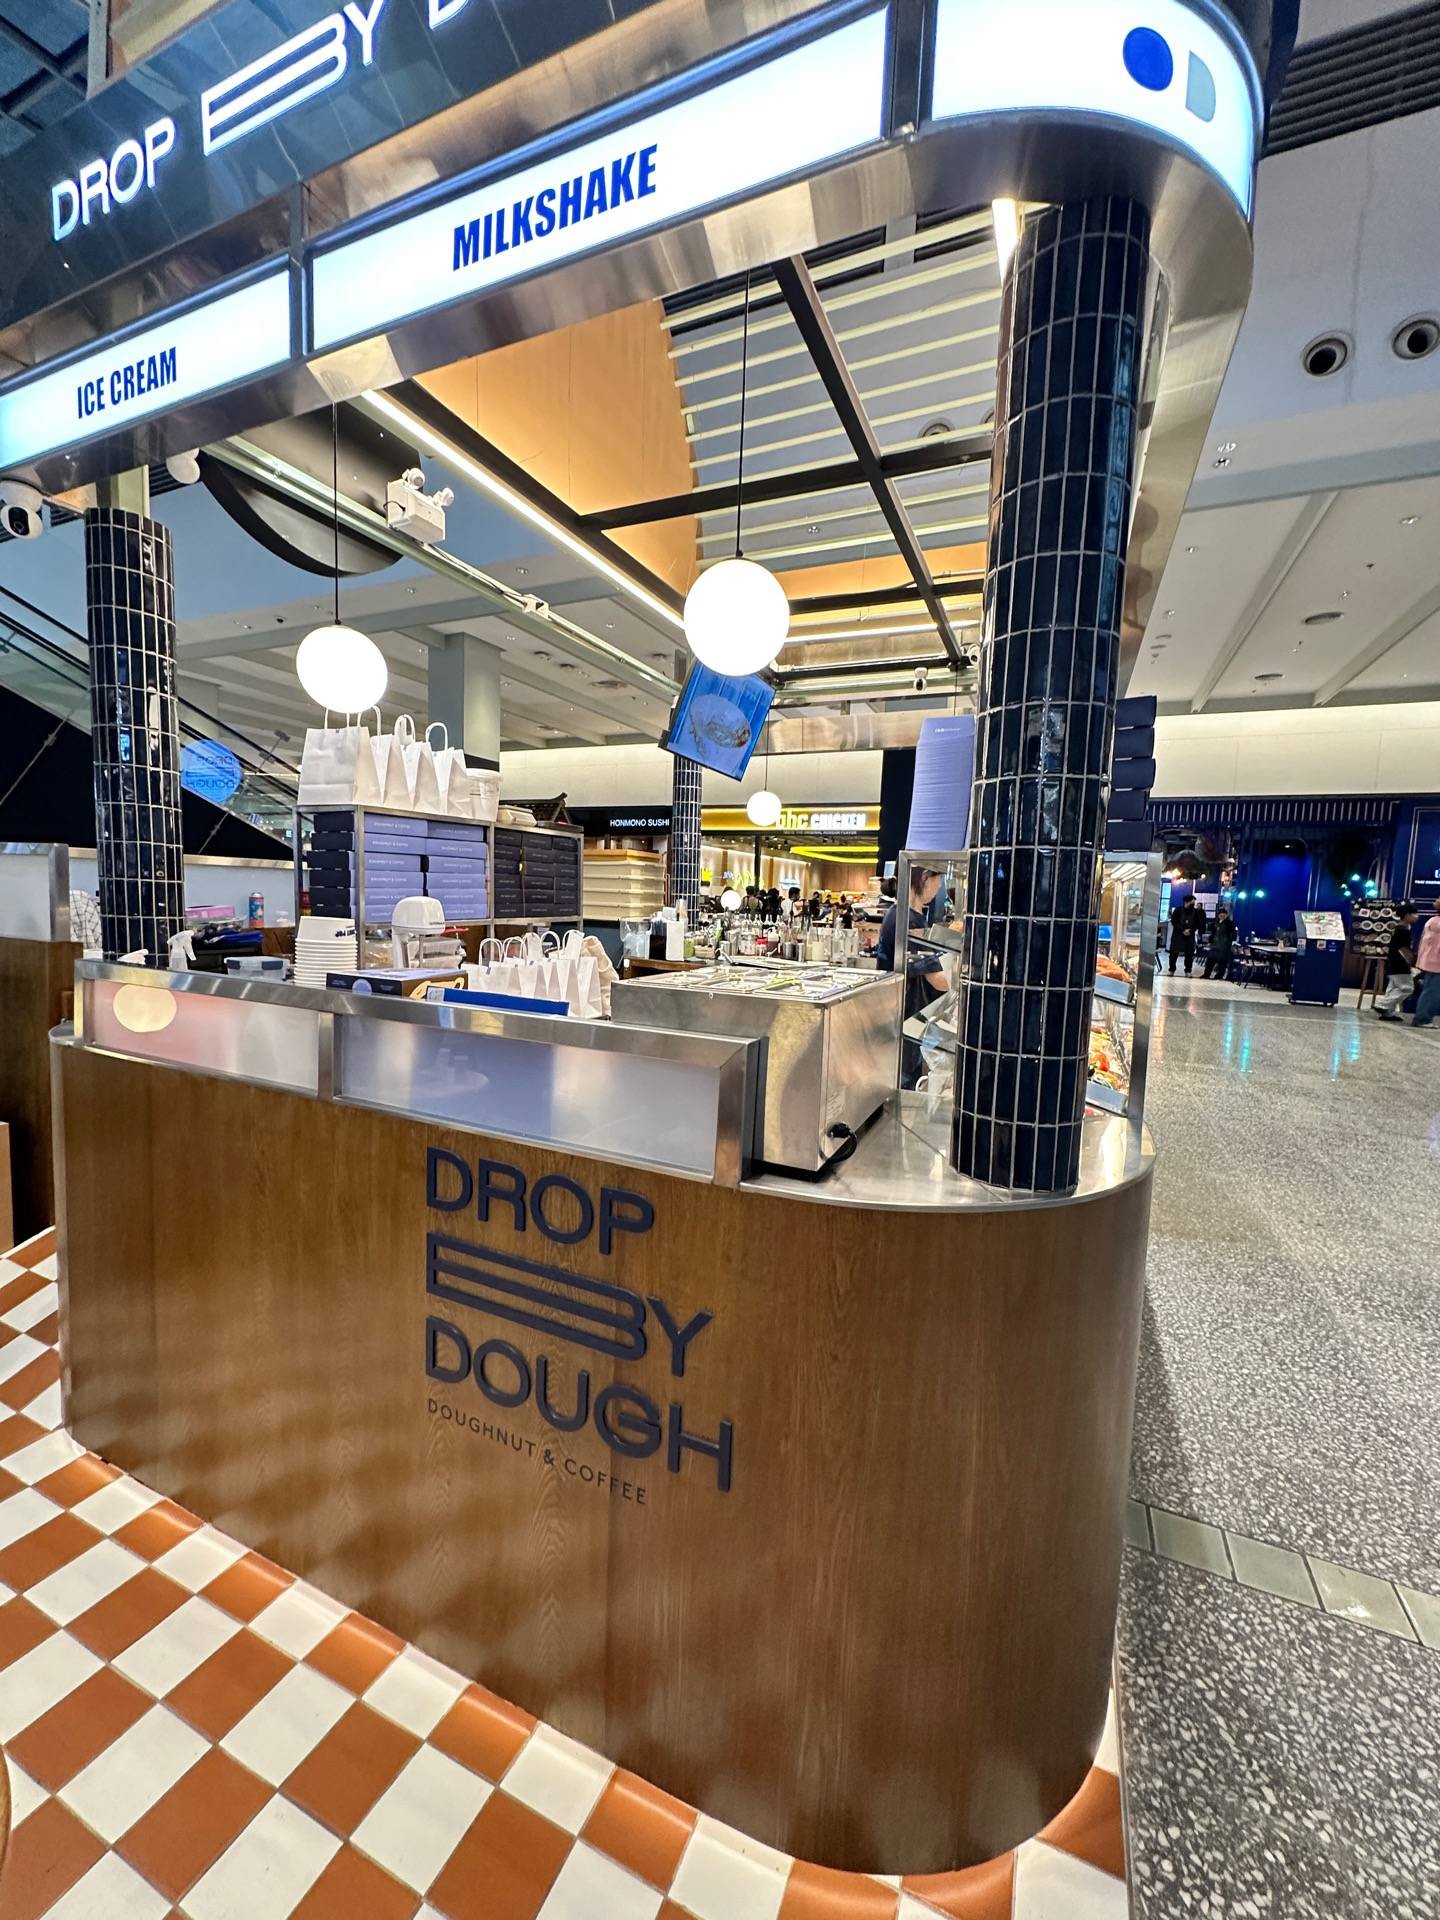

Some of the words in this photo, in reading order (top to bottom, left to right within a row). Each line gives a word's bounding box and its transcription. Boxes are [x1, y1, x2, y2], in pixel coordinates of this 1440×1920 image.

[51, 115, 176, 241] DROP
[453, 144, 658, 271] MILKSHAKE
[77, 376, 106, 420] ICE
[110, 347, 178, 406] CREAM
[610, 819, 646, 827] HONMONO
[647, 818, 670, 827] SUSHI
[810, 812, 867, 829] CHICKEN
[426, 1146, 655, 1255] DROP
[426, 1316, 733, 1492] DOUGH
[428, 1397, 537, 1457] DOUGHNUT
[543, 1448, 557, 1466] &
[564, 1458, 646, 1505] COFFEE
